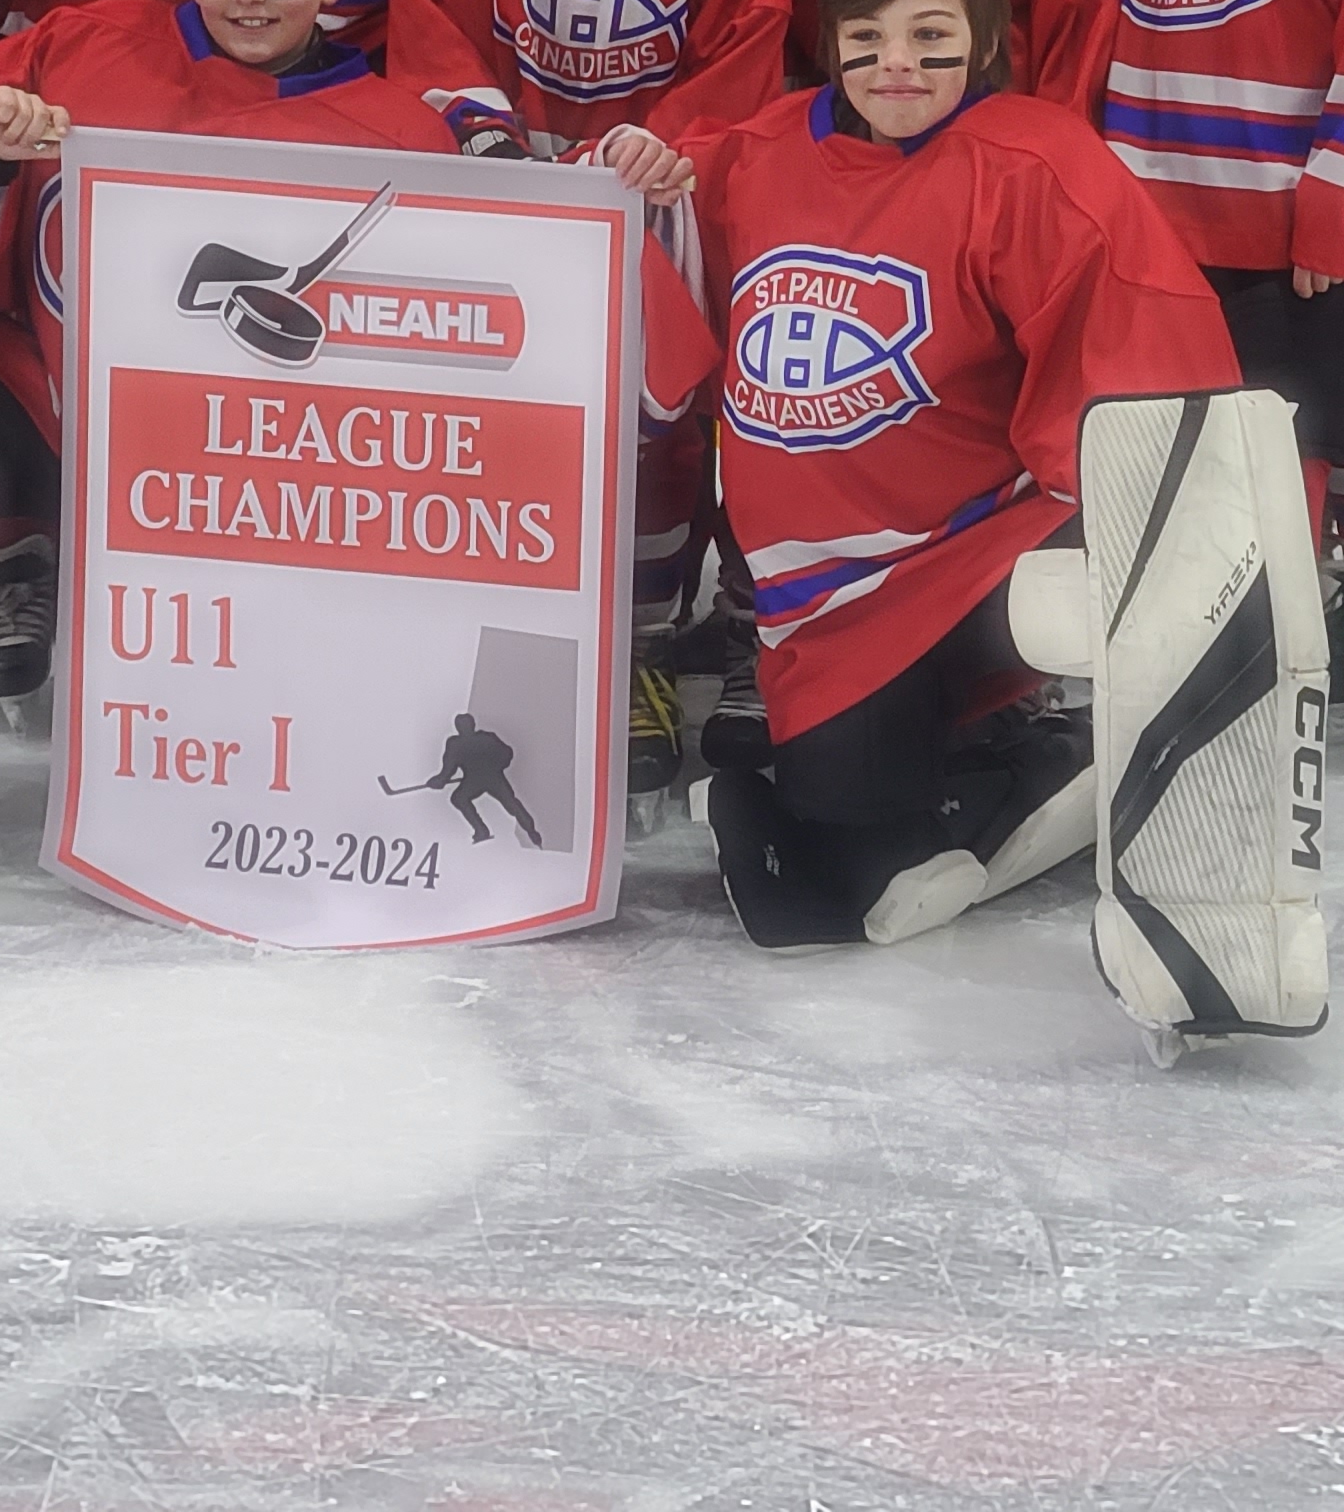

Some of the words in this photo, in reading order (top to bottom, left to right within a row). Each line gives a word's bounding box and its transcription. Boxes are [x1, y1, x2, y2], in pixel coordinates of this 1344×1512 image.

[514, 21, 659, 79] CANADIENS
[327, 290, 506, 346] NEAHL
[203, 392, 484, 478] LEAGUE
[128, 470, 557, 564] CHAMPIONS
[107, 584, 238, 670] U11
[103, 700, 241, 788] Tier
[267, 715, 294, 793] I
[1291, 685, 1326, 872] CCM
[204, 820, 442, 891] 2023-2024
